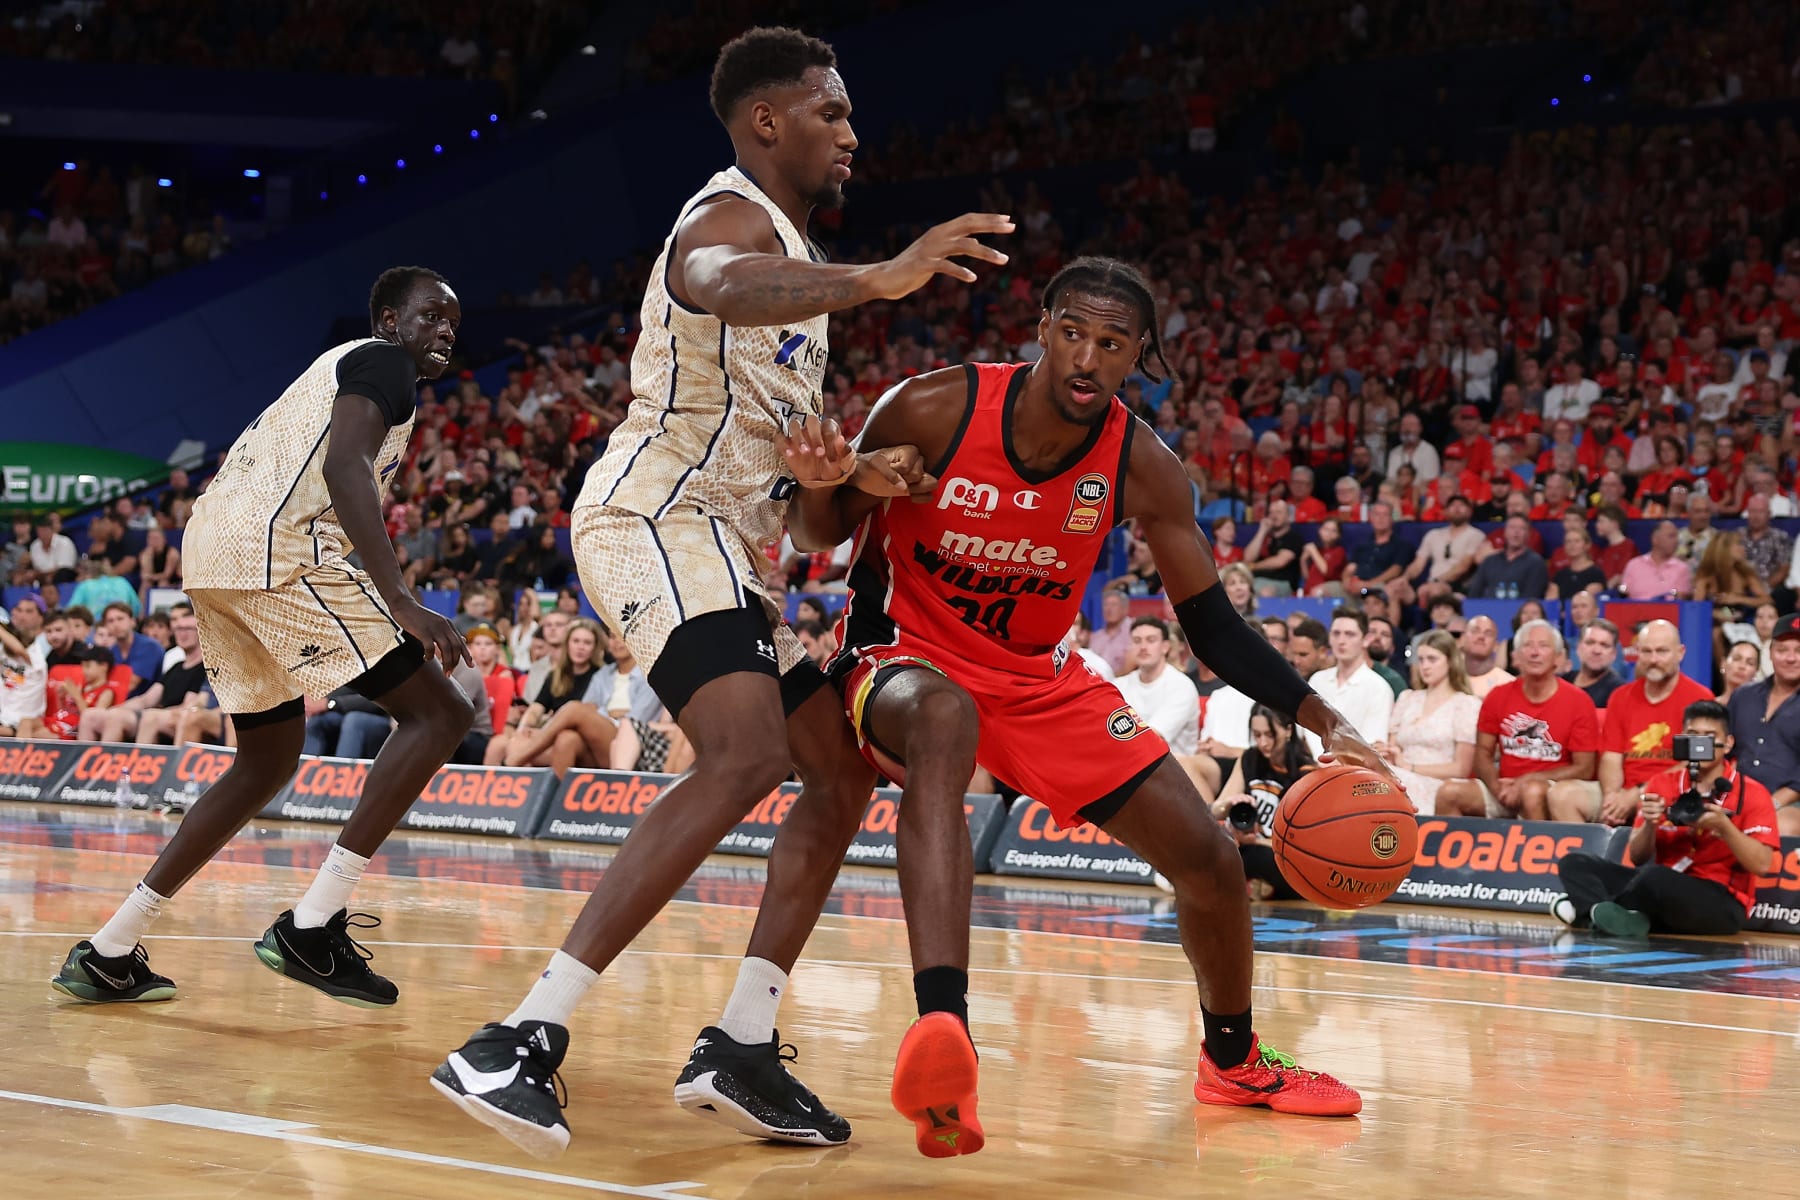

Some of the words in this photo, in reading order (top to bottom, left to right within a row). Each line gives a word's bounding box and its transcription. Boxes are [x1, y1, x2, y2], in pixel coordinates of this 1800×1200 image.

[1082, 483, 1101, 497] NBL
[963, 508, 991, 520] bank
[939, 529, 1067, 571] mate.
[913, 540, 1076, 601] WILDCATS
[1002, 565, 1050, 579] mobile
[1113, 716, 1133, 734] NBL
[420, 768, 532, 808] Coates
[563, 773, 666, 815] Coate
[1004, 850, 1071, 868] Equipped
[1070, 854, 1092, 870] for
[1091, 858, 1152, 876] anything
[1396, 878, 1473, 899] Equipped
[1472, 883, 1499, 901] for
